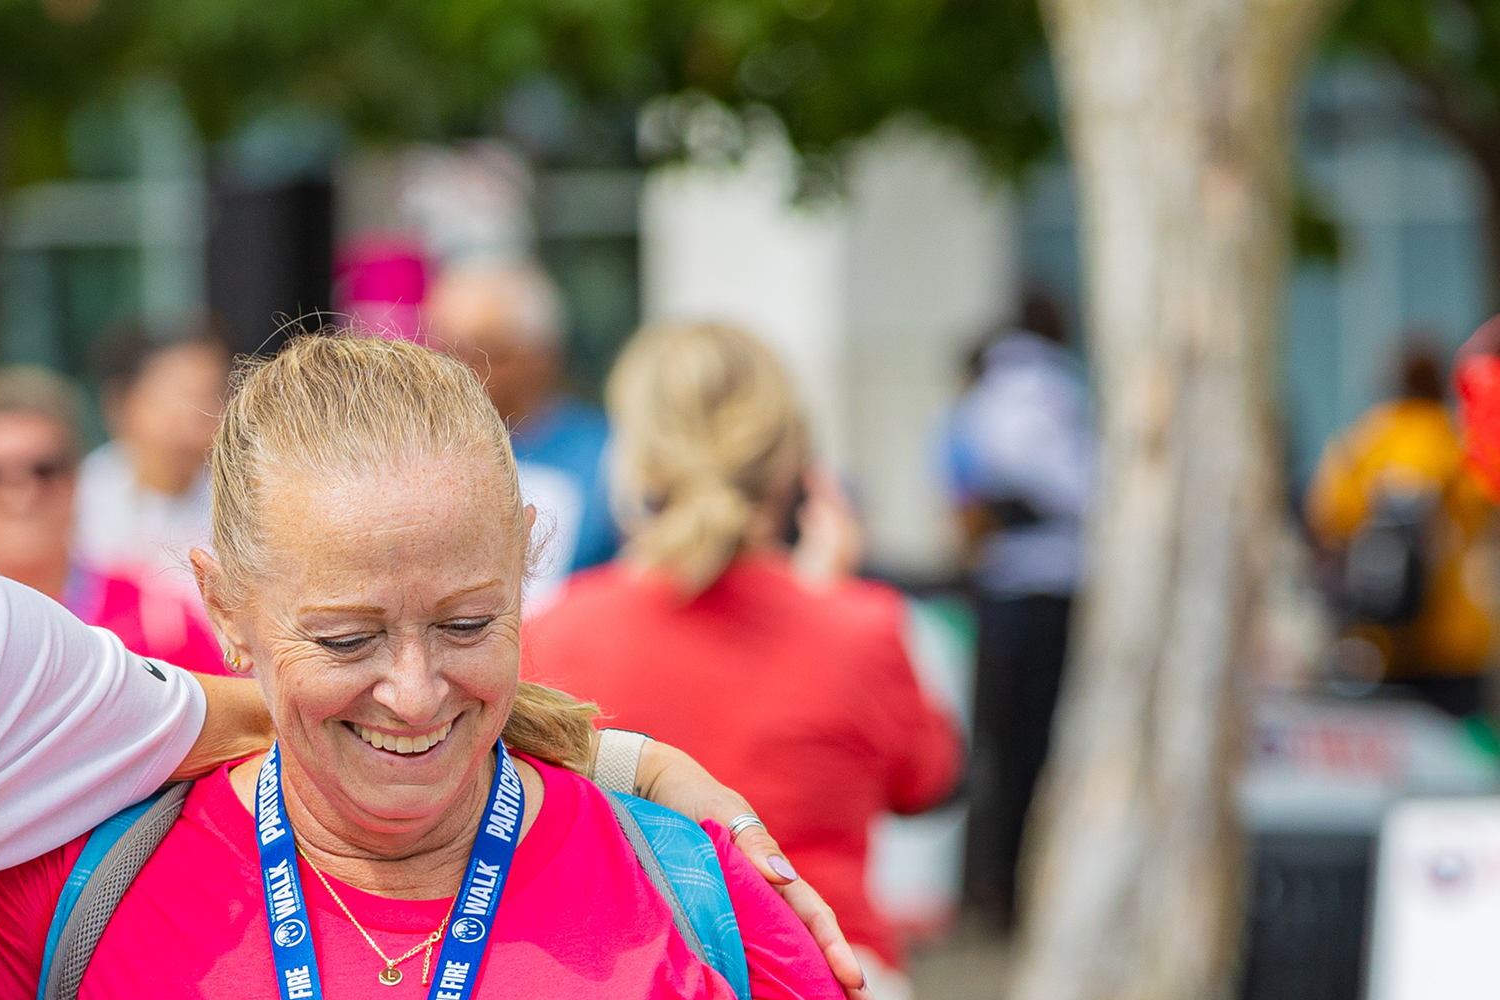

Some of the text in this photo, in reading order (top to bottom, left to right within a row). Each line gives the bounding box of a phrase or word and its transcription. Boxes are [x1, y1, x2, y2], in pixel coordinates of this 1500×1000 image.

[269, 858, 296, 921] WALK
[463, 860, 500, 915] WALK
[285, 965, 315, 1000] FIRE
[443, 960, 470, 998] FIRE
